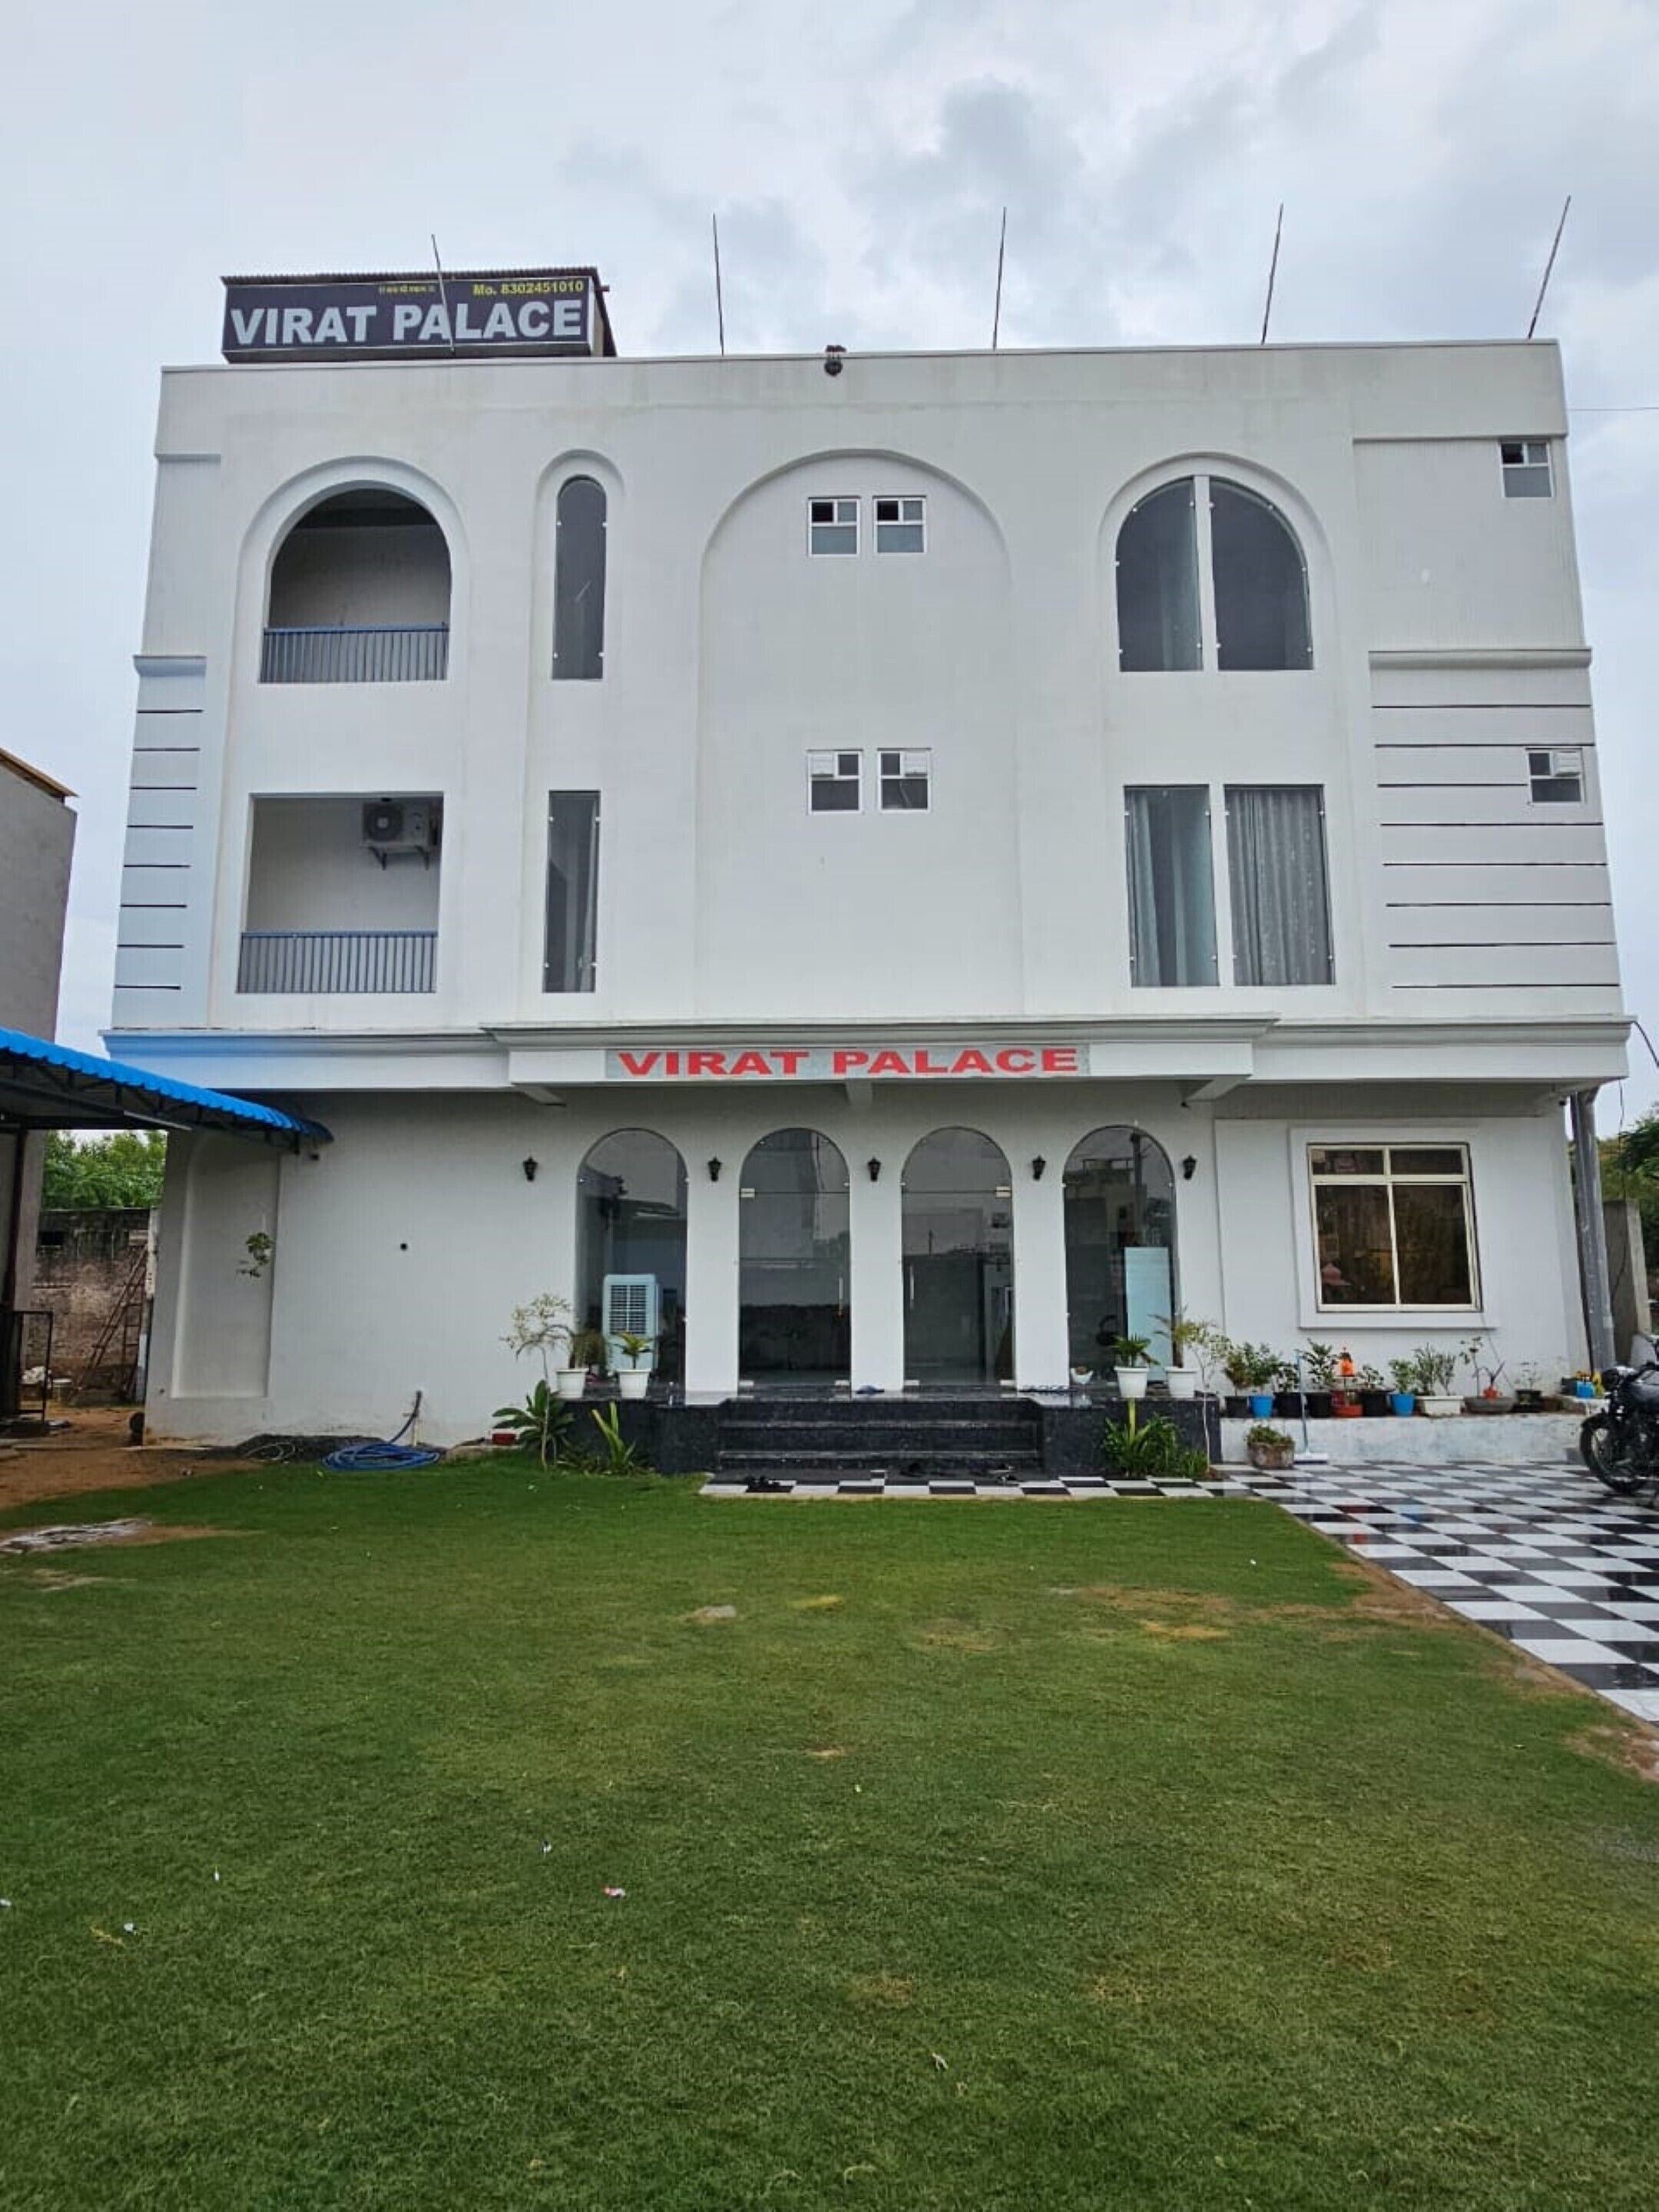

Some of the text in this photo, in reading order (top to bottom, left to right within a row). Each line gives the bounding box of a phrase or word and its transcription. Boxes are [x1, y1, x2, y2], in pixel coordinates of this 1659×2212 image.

[472, 280, 584, 296] Mo. 8302451010
[230, 299, 582, 346] VIRAT PALACE
[618, 1047, 1078, 1077] VIRAT PALACE
